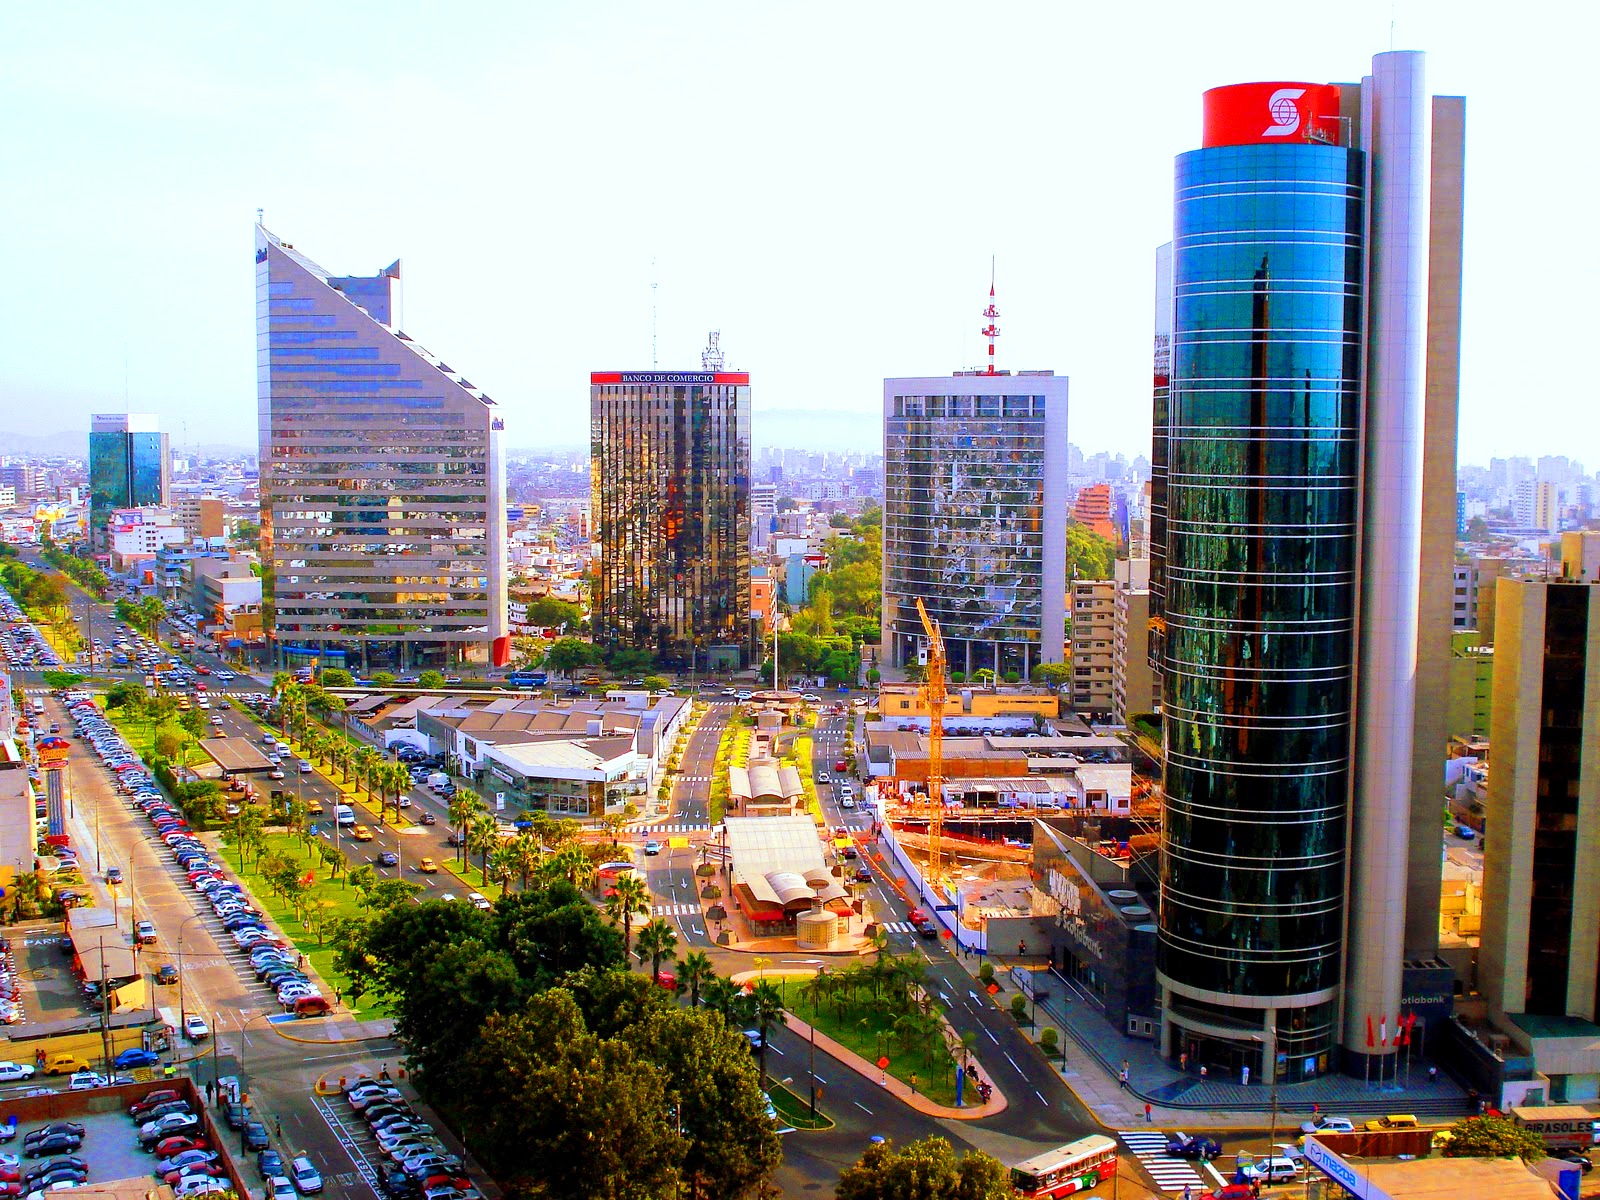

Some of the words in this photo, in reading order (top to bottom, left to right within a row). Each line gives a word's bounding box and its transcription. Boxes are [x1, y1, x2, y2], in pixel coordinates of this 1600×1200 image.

[622, 374, 652, 382] BANCO
[654, 374, 666, 382] DE
[667, 374, 714, 382] COMERCIO
[23, 938, 61, 946] PARE
[1401, 996, 1445, 1004] otiabank
[321, 1108, 339, 1128] ZONA
[341, 1138, 354, 1149] DE
[1525, 1122, 1593, 1133] GIRASOLES
[1323, 1153, 1356, 1187] mazda
